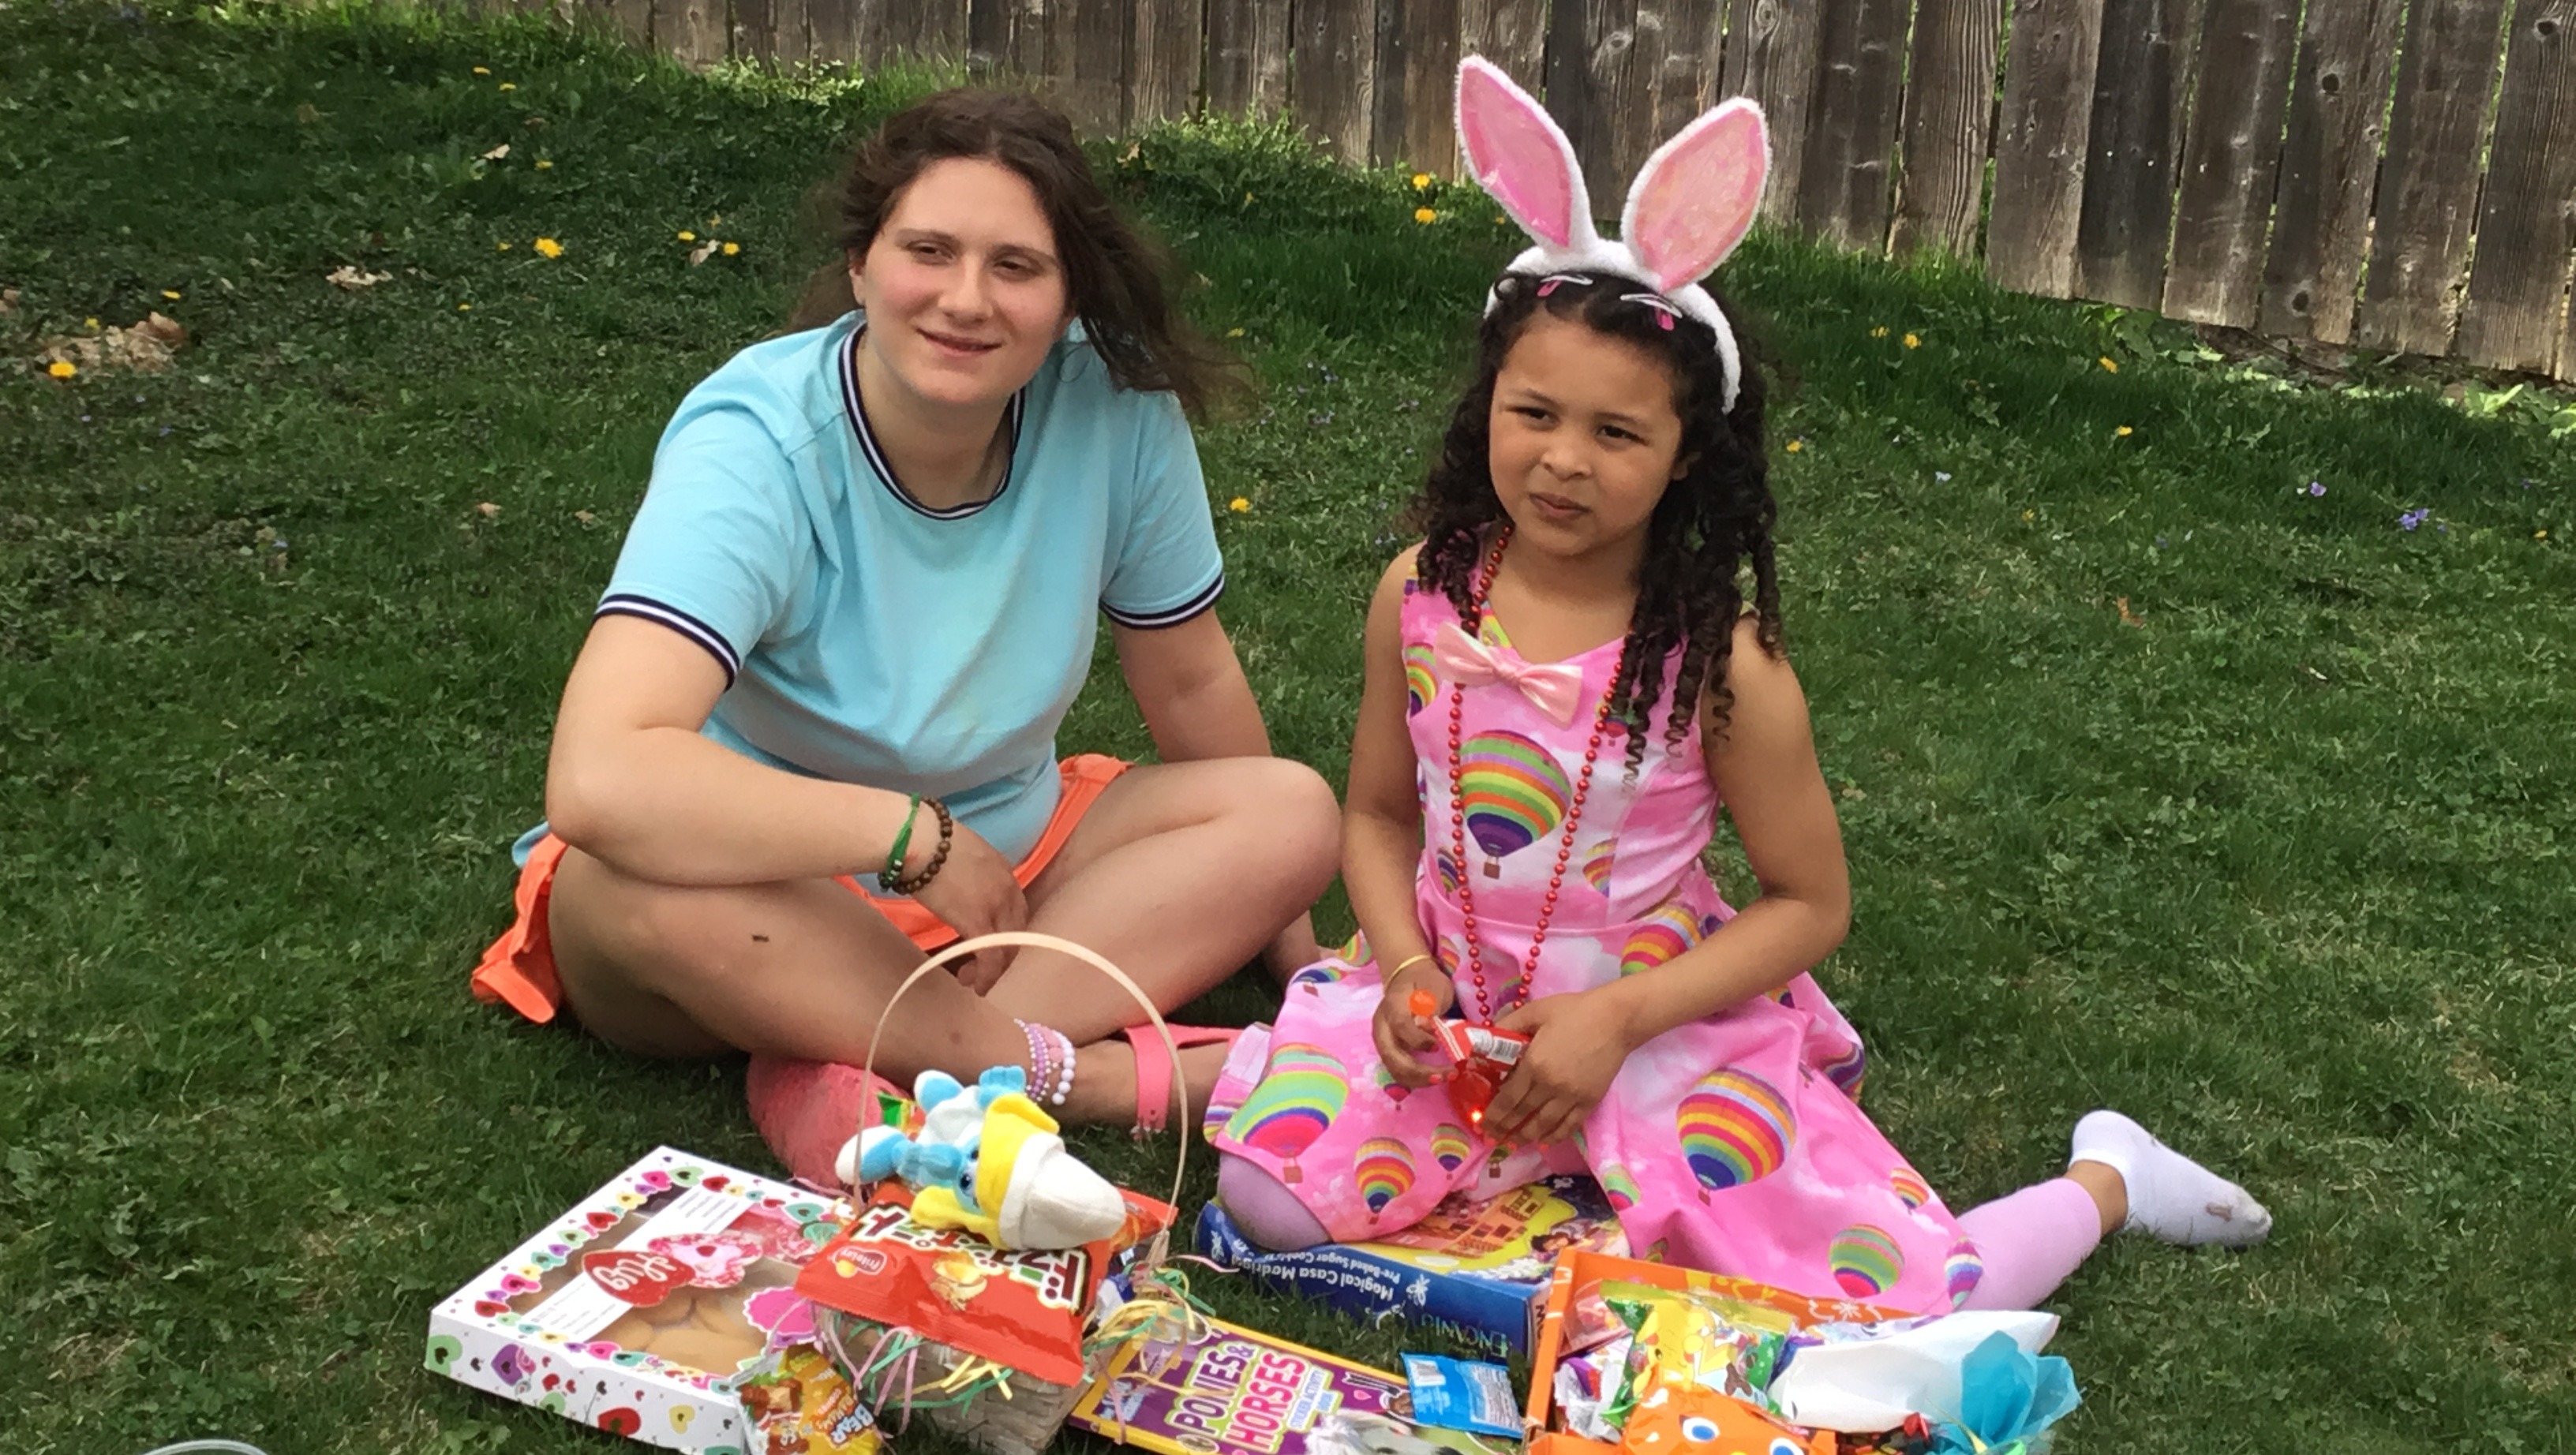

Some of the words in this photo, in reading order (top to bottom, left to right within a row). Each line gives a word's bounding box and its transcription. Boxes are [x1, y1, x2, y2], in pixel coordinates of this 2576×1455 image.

[1316, 1253, 1349, 1270] Sugar
[1350, 1259, 1401, 1285] Pre-Baked
[1299, 1268, 1338, 1285] Casa
[1340, 1273, 1394, 1301] Magical
[1174, 1350, 1247, 1432] PONIES
[1225, 1353, 1306, 1449] HORSES
[831, 1403, 874, 1443] BEAR
